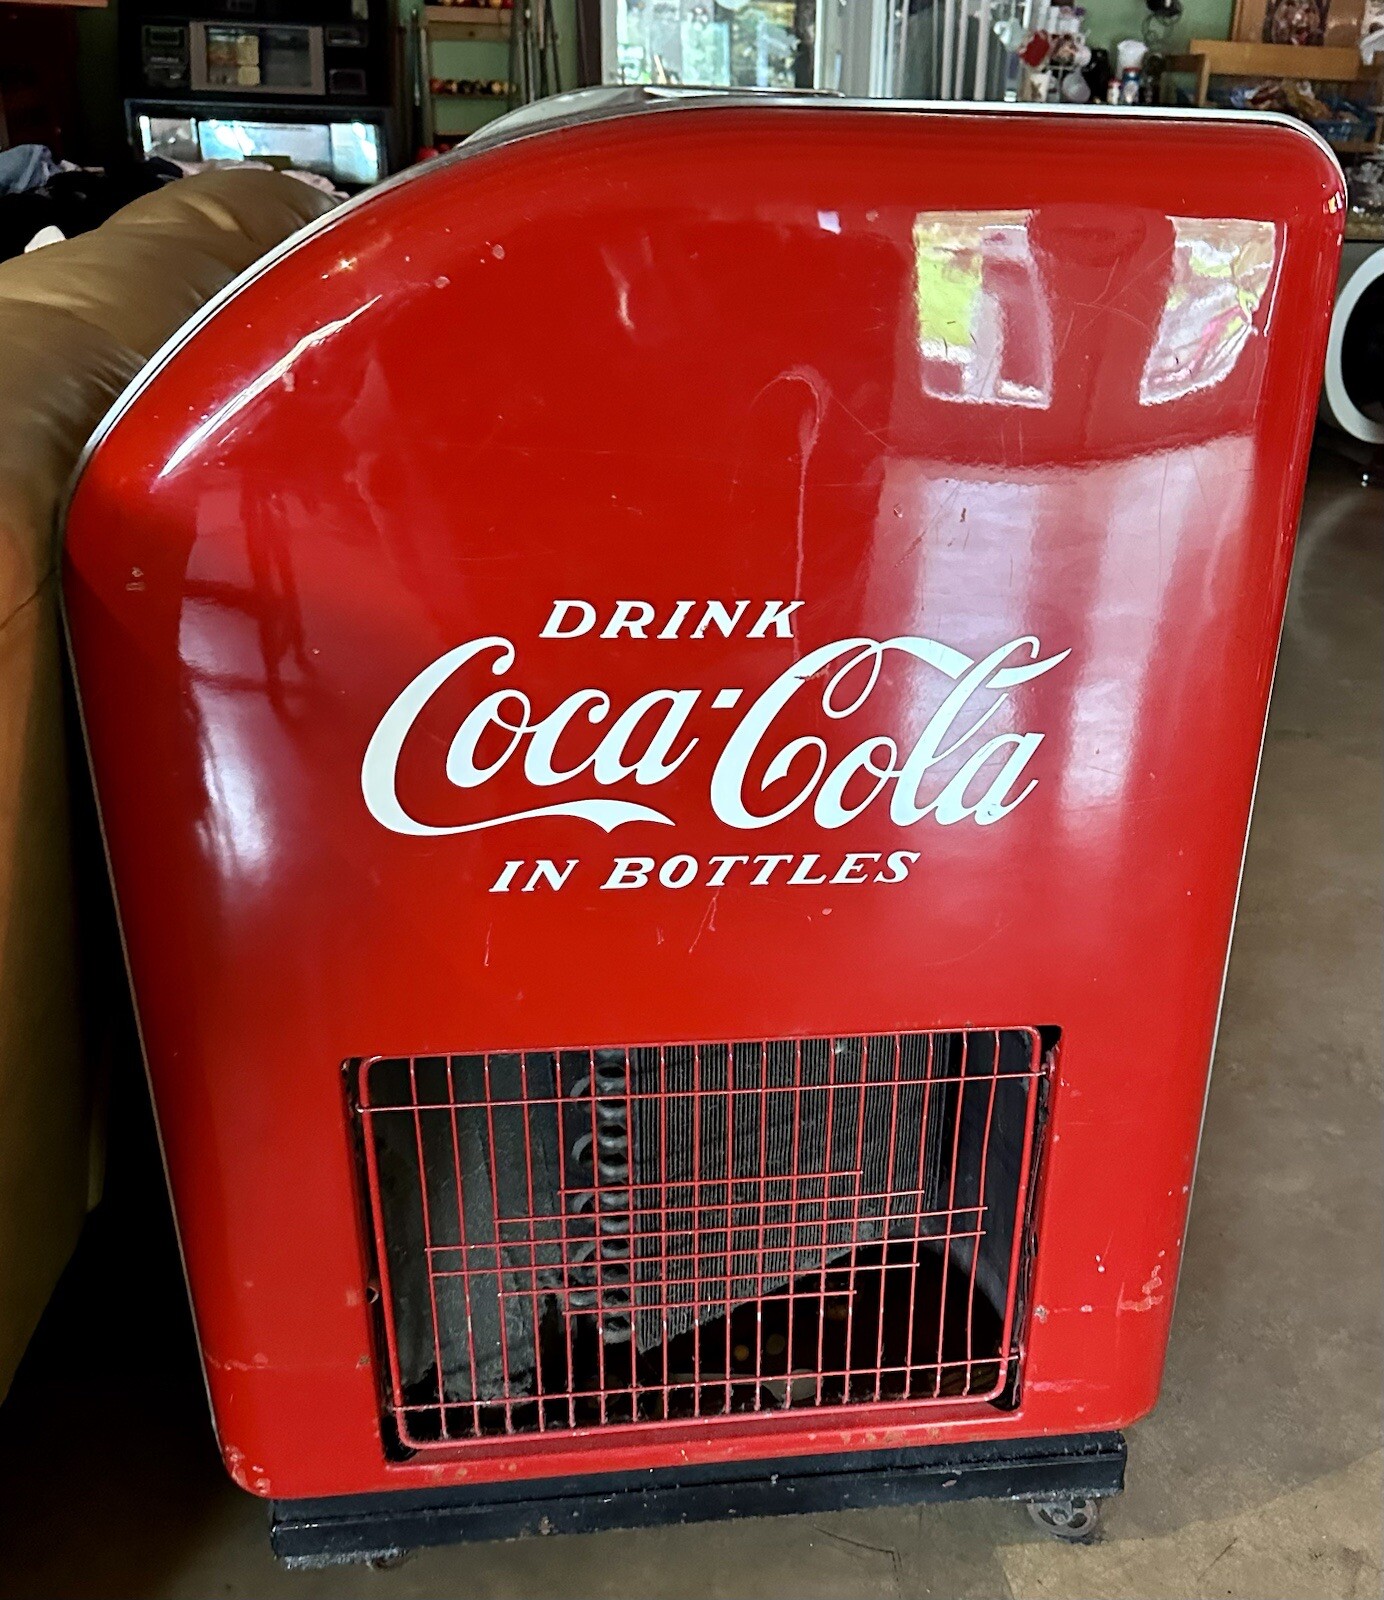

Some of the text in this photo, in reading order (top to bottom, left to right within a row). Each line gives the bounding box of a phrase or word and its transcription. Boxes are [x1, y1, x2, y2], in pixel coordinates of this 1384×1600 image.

[539, 600, 805, 640] DRINK
[360, 635, 1072, 837] Coca-Cola
[489, 850, 922, 893] IN BOTTLES
